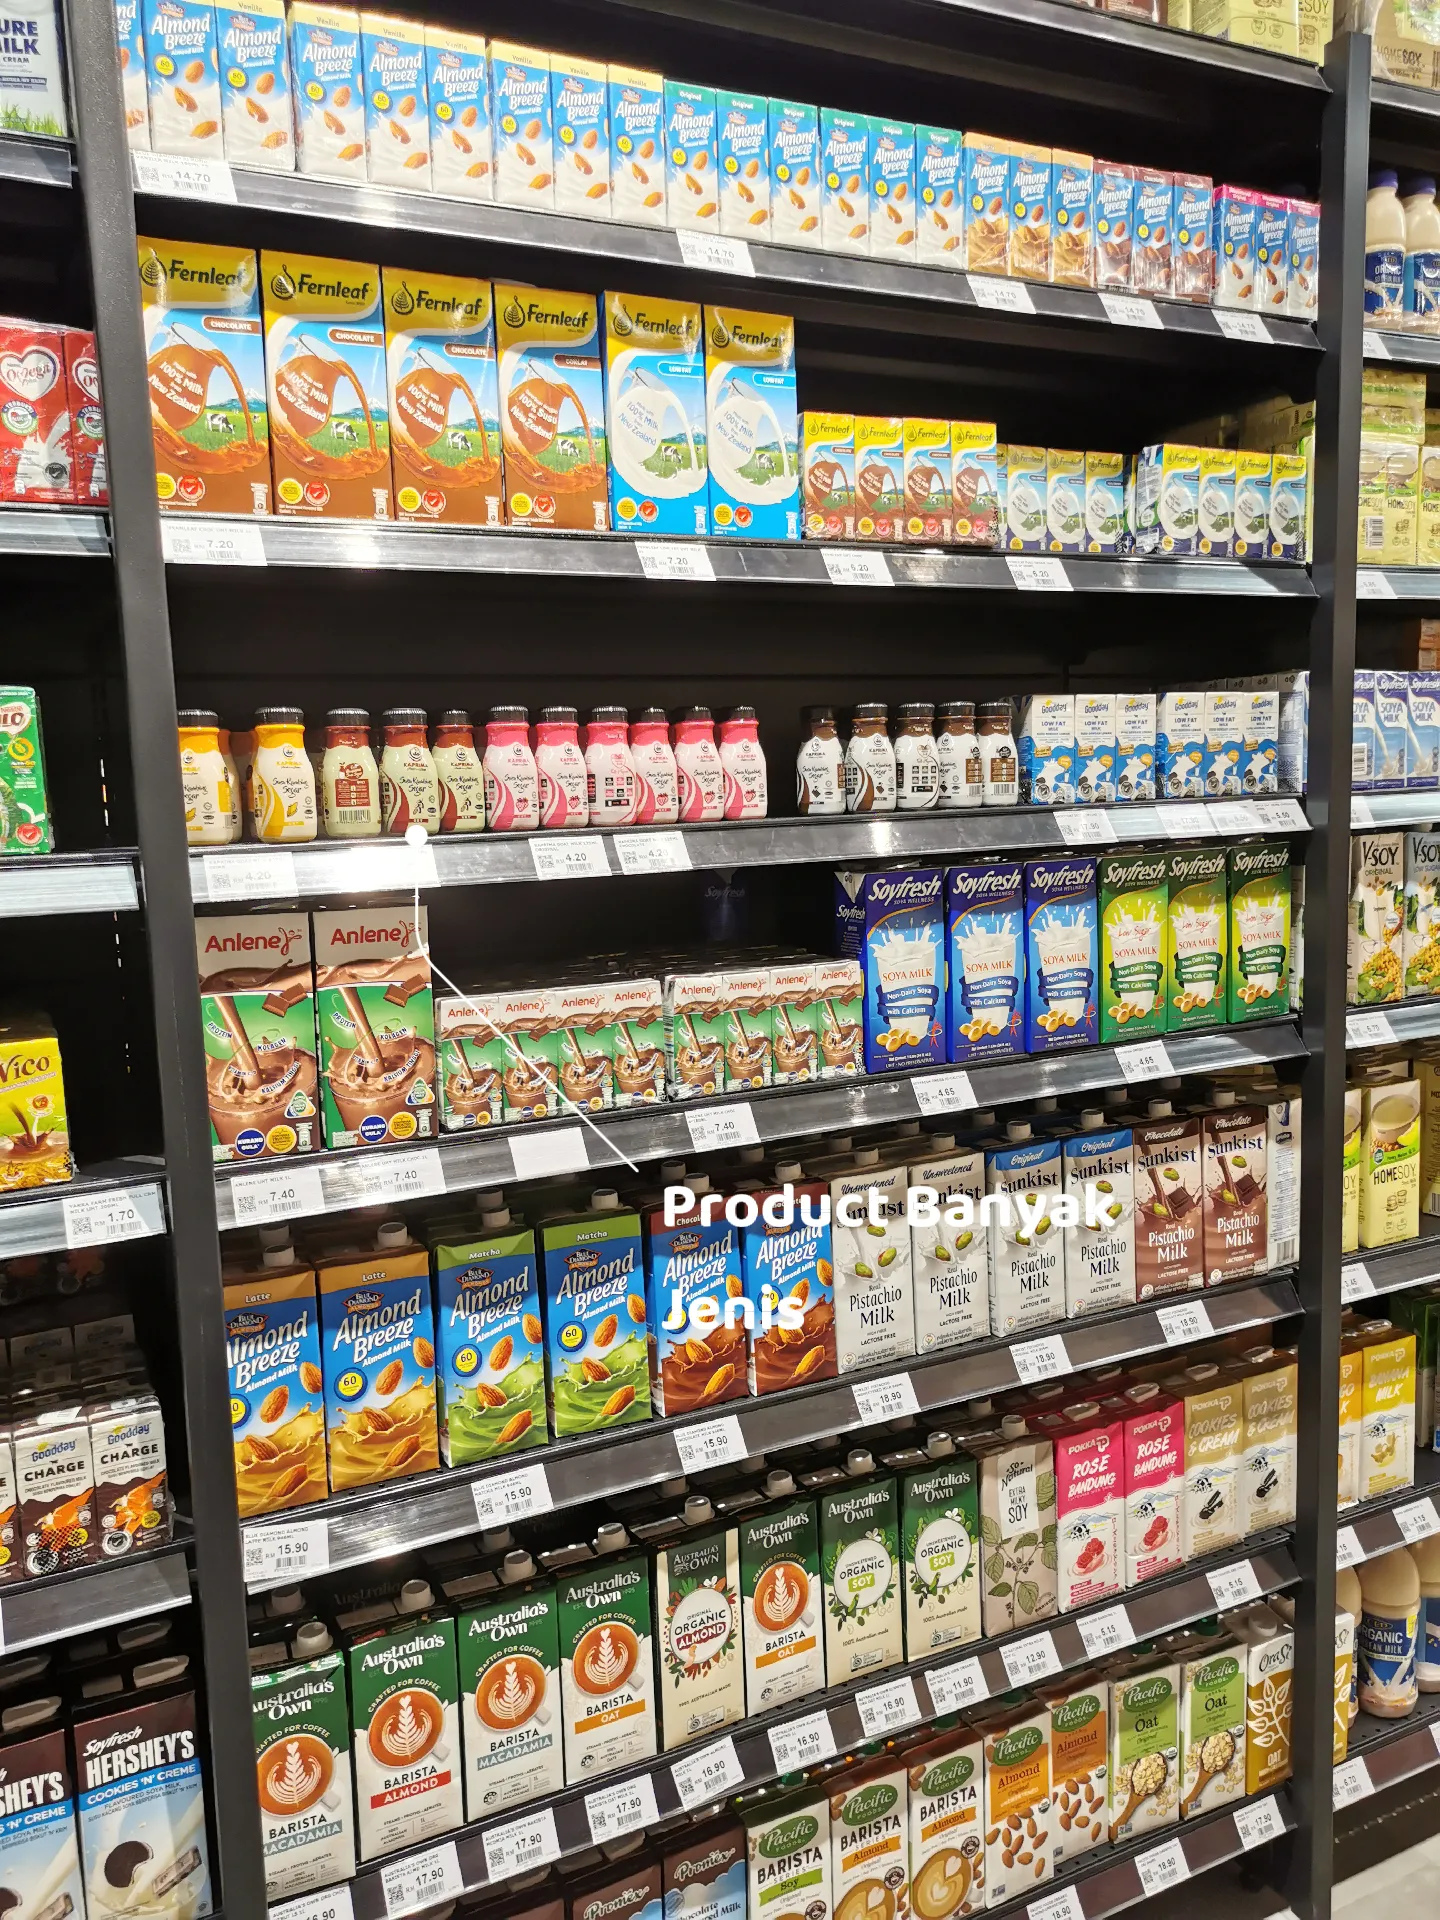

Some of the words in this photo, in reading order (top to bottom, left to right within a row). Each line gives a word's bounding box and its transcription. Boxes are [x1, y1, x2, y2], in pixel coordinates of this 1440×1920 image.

[151, 13, 211, 35] Almond
[316, 16, 340, 28] Vanilla
[164, 30, 206, 50] Breeze
[303, 41, 357, 62] Almond
[315, 57, 353, 77] Breeze
[433, 64, 484, 85] Almond
[444, 79, 479, 98] Breeze
[499, 77, 547, 96] Almond
[510, 92, 543, 109] Breeze
[670, 113, 713, 131] Almond
[679, 125, 710, 142] Breeze
[175, 170, 211, 183] 14.70
[970, 161, 1008, 179] Almond
[978, 174, 1004, 189] Breeze
[168, 258, 247, 288] Fernleaf
[298, 279, 369, 300] Fernleaf
[416, 288, 482, 317] Fernleaf
[527, 303, 588, 328] Fernleaf
[635, 312, 692, 336] Fernleaf
[210, 319, 252, 332] CHOCOLATE
[335, 330, 375, 343] CHOCOLATE
[148, 374, 168, 394] New
[166, 388, 200, 414] Zealand
[182, 378, 204, 396] Milk
[820, 422, 850, 434] Fernleaf
[206, 539, 234, 550] 7.20
[667, 556, 688, 566] 7.20
[1041, 702, 1069, 715] Goodday
[1380, 702, 1403, 714] SOYA
[1383, 712, 1400, 723] MILK
[0, 713, 25, 726] ILO
[565, 851, 587, 863] 4.20
[1363, 841, 1399, 867] V-SOY
[245, 870, 272, 881] 4.20
[1030, 862, 1094, 894] Soyfresh
[1103, 859, 1165, 888] Soyfresh
[1365, 868, 1393, 876] ORIGINAL
[868, 875, 941, 906] Soyfresh
[204, 932, 281, 954] Anlene
[330, 921, 401, 946] Anlene
[1114, 947, 1137, 958] SOYA
[1137, 945, 1157, 956] MILK
[883, 971, 907, 983] SOYA
[909, 968, 933, 979] MILK
[615, 989, 647, 1002] Anlene
[887, 987, 914, 1000] Non-Dairy
[915, 986, 932, 995] Soya
[505, 1000, 540, 1013] Anlene
[902, 1006, 926, 1014] Calcium
[207, 1022, 233, 1039] PROTEIN
[257, 1037, 286, 1051] KOLAGEN
[938, 1088, 955, 1097] 4.65
[715, 1121, 735, 1133] 7.40
[1215, 1114, 1252, 1130] Chocolate
[1081, 1137, 1115, 1153] Original
[1207, 1134, 1263, 1159] Sunkist
[1070, 1156, 1130, 1184] Sunkist
[1373, 1163, 1417, 1185] HOMESOY
[270, 1189, 295, 1201] 7.40
[108, 1209, 135, 1222] 1.70
[1217, 1211, 1260, 1233] Pistachio
[1225, 1231, 1254, 1249] Milk
[468, 1248, 501, 1259] Matcha
[1081, 1240, 1127, 1261] Pistachio
[362, 1271, 386, 1283] Latte
[1089, 1259, 1120, 1278] Milk
[245, 1293, 271, 1303] Latte
[450, 1266, 530, 1326] Almond
[850, 1286, 902, 1312] Pistachio
[333, 1288, 421, 1351] Almond
[467, 1293, 523, 1340] Breeze
[860, 1306, 895, 1329] Milk
[1180, 1316, 1198, 1327] 18.90
[353, 1318, 413, 1364] Breeze
[860, 1334, 882, 1345] LACTOSE
[883, 1332, 896, 1340] FREE
[362, 1348, 392, 1367] Almond
[393, 1340, 411, 1352] Milk
[236, 1341, 300, 1389] Breeze
[343, 1376, 357, 1386] 60
[879, 1391, 902, 1404] 18.90
[1375, 1383, 1402, 1402] MILK
[1188, 1414, 1238, 1440] COOKIES
[703, 1435, 727, 1449] 15.90
[1198, 1430, 1239, 1452] CREAM
[31, 1440, 77, 1462] Goodday
[100, 1444, 159, 1465] CHARGE
[24, 1460, 85, 1482] CHARGE
[1072, 1455, 1109, 1480] ROSE
[1008, 1487, 1026, 1497] EXTRA
[1068, 1472, 1116, 1499] BANDUNG
[827, 1489, 890, 1517] Australia's
[844, 1506, 874, 1524] Own
[1008, 1502, 1029, 1525] SOY
[278, 1542, 309, 1555] 15.90
[840, 1559, 885, 1580] ORGANIC
[852, 1576, 872, 1590] SOY
[675, 1609, 727, 1636] ORGANIC
[1101, 1624, 1116, 1634] 5.15
[677, 1623, 726, 1649] ALMOND
[1361, 1625, 1403, 1643] RGANIC
[361, 1634, 446, 1671] Australia's
[1026, 1649, 1046, 1663] 12.90
[952, 1676, 974, 1691] 11.90
[1204, 1695, 1228, 1712] Oat
[600, 1710, 620, 1723] OAT
[1134, 1716, 1160, 1733] Oat
[83, 1725, 142, 1757] Soyfresh
[797, 1731, 820, 1747] 16.90
[997, 1732, 1039, 1757] Pacific
[86, 1730, 195, 1789] HERSHEY'S
[478, 1737, 551, 1769] MACADAMIA
[1267, 1749, 1282, 1767] OAT
[87, 1779, 139, 1805] COOKIES
[157, 1764, 196, 1781] CREME
[384, 1765, 437, 1789] BARISTA
[997, 1764, 1041, 1789] Almond
[383, 1777, 439, 1804] ALMOND
[763, 1821, 814, 1852] Pacific
[674, 1847, 737, 1882] Promex
[757, 1849, 824, 1885] BARISTA
[1157, 1857, 1176, 1872] 18.90
[416, 1867, 444, 1887] 17.90
[779, 1875, 800, 1892] Soy
